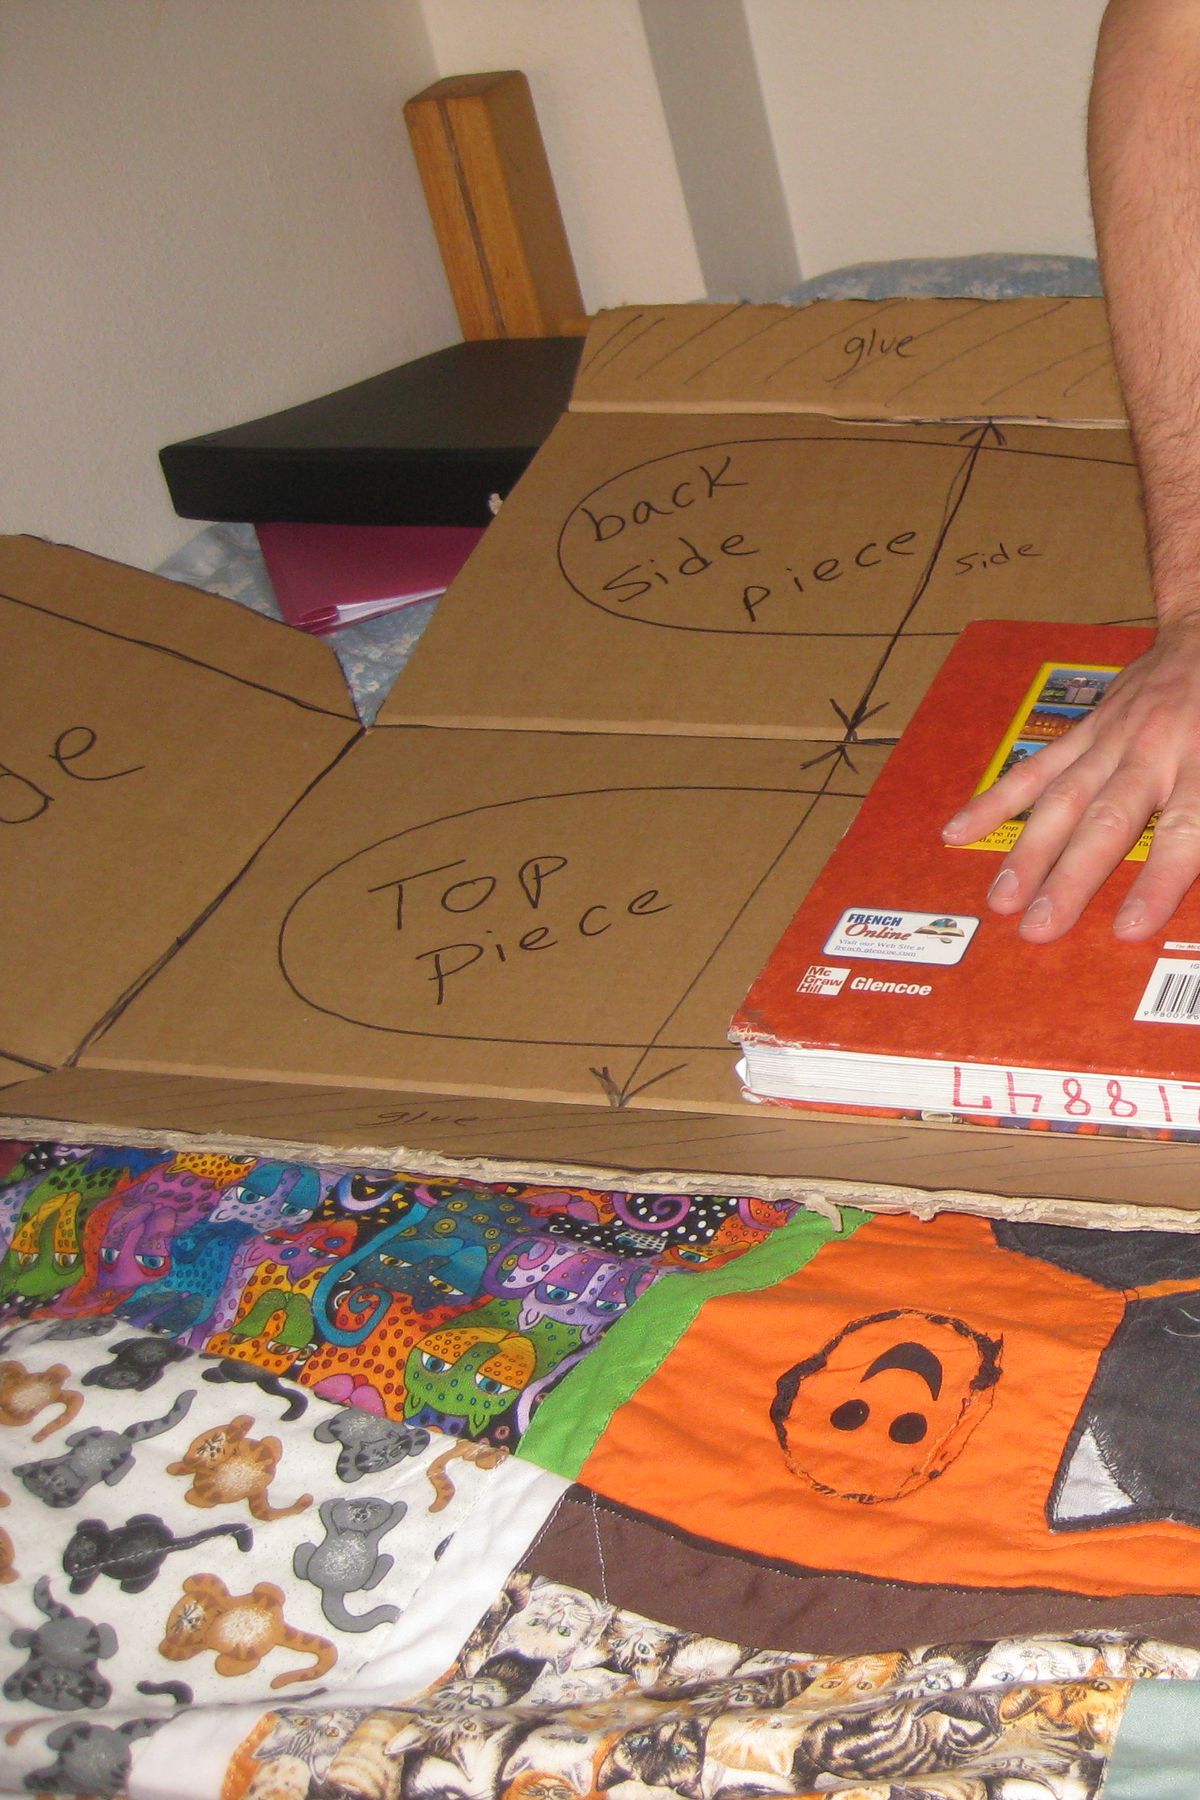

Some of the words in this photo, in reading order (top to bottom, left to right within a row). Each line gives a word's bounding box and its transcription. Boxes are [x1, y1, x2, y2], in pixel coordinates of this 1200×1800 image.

[823, 328, 917, 384] glue
[743, 531, 917, 622] piece
[846, 913, 903, 927] FRENCH
[844, 922, 913, 941] Online
[799, 983, 823, 994] Hill
[803, 975, 843, 987] Graw
[850, 976, 933, 996] Glencoe
[358, 1111, 480, 1127] glue
